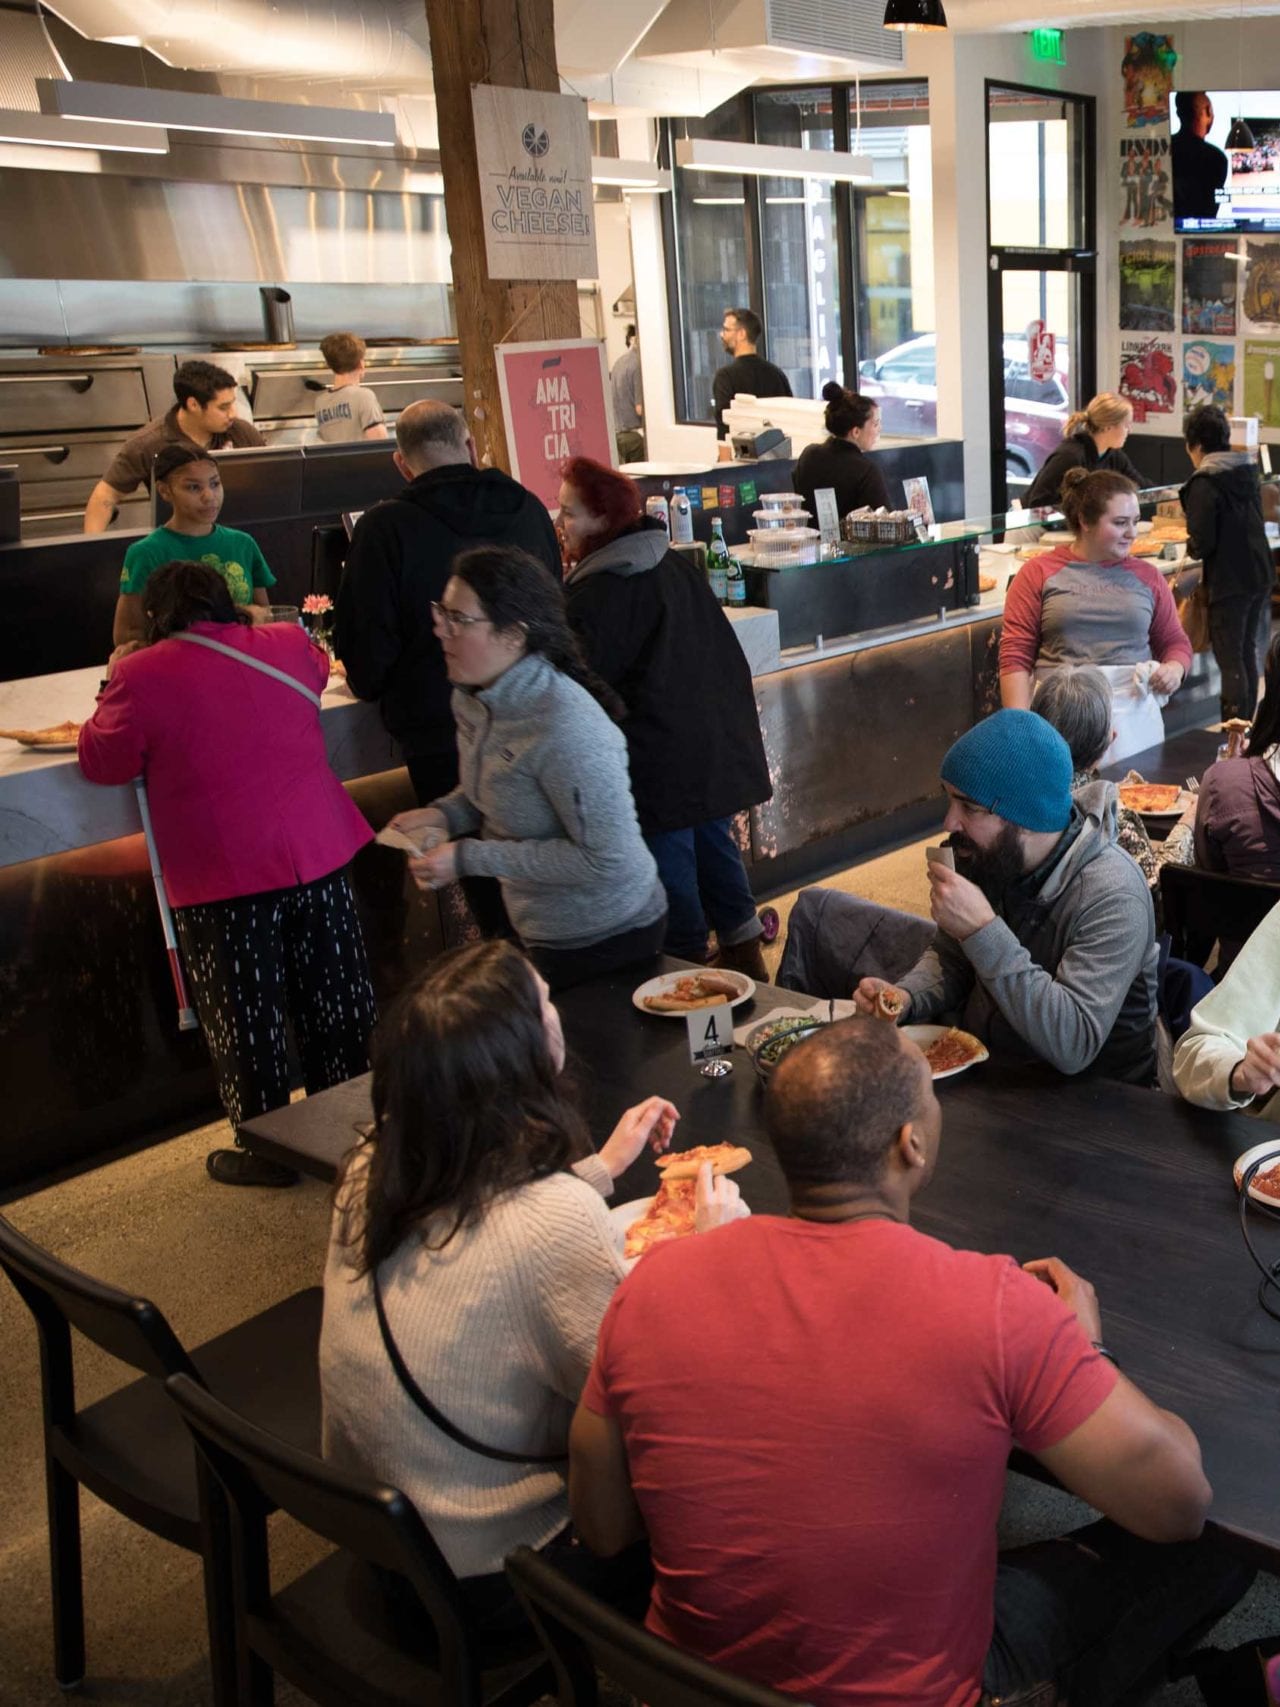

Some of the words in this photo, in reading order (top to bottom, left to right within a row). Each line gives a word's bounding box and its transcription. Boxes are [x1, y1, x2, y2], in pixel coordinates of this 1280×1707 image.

[509, 166, 546, 183] Available
[496, 184, 583, 212] VEGAN
[491, 209, 591, 236] CHEESE!
[536, 375, 571, 405] AMA
[547, 402, 576, 432] TRI
[544, 432, 570, 460] CIA
[704, 1014, 720, 1045] 4
